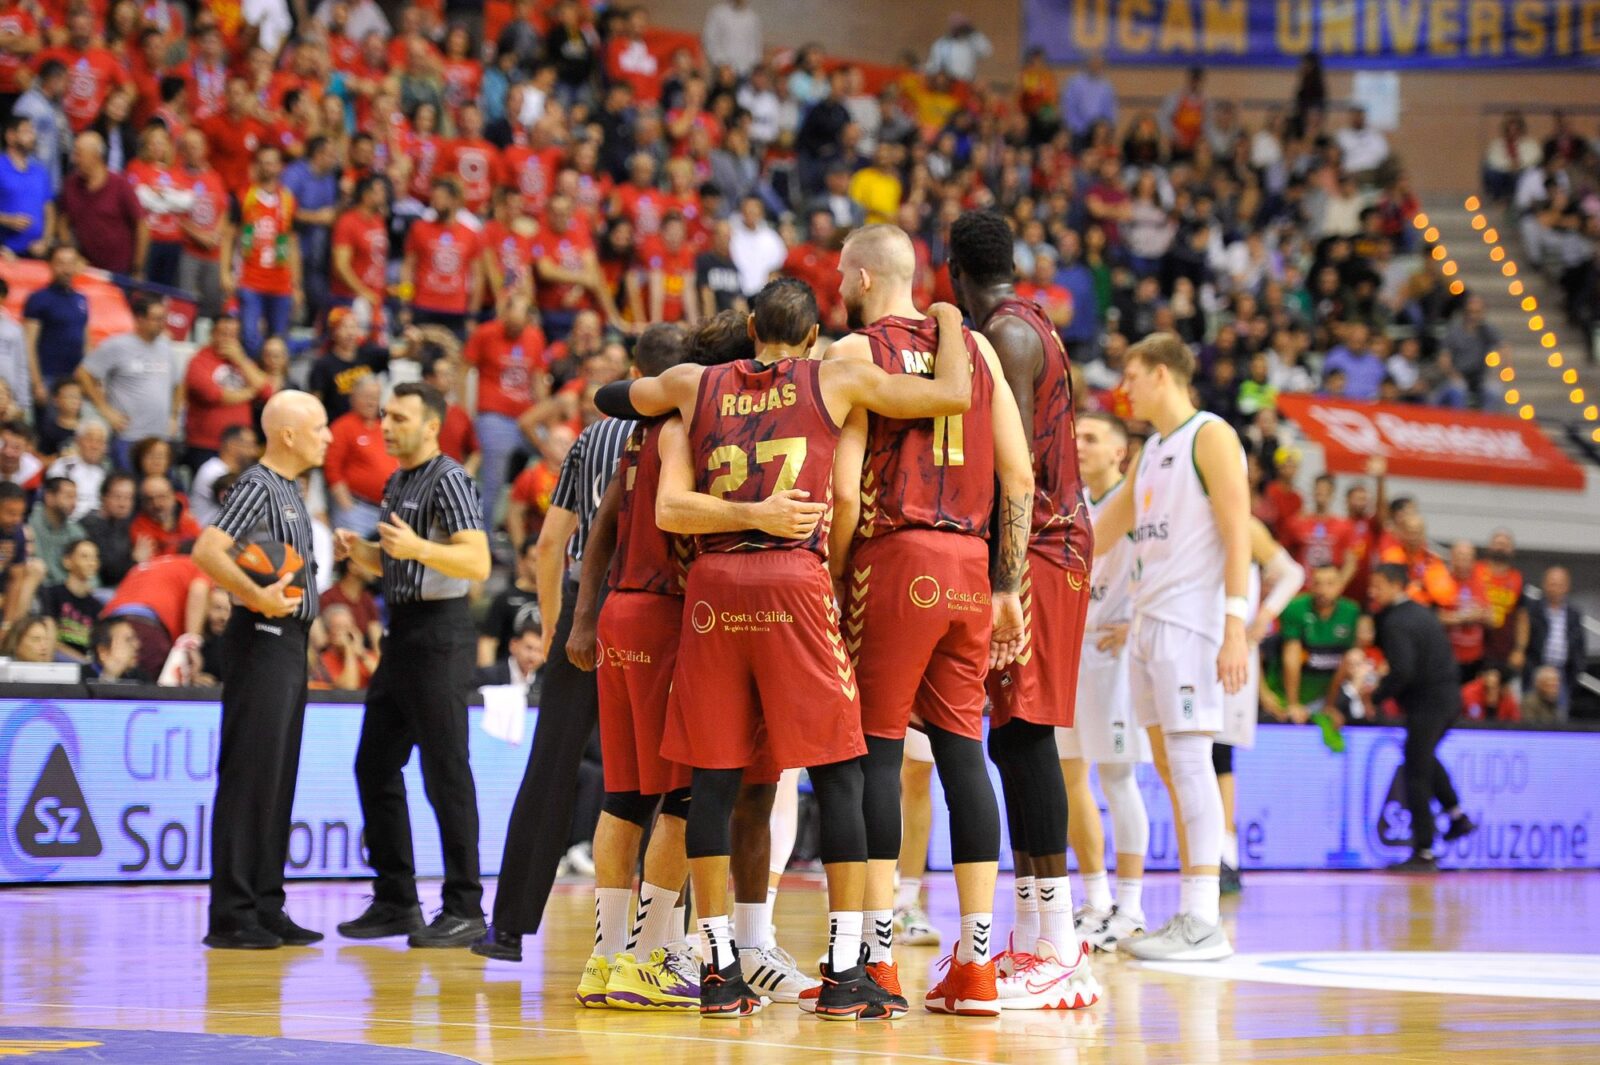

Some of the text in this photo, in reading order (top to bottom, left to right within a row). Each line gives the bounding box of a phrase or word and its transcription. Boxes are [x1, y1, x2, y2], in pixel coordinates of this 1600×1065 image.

[1071, 0, 1247, 54] UCAM
[720, 383, 797, 416] ROJAS
[933, 413, 964, 466] 11
[707, 436, 807, 501] 27
[720, 610, 794, 623] Costa Cálida
[945, 588, 972, 602] Costa
[124, 706, 216, 781] Gru
[34, 796, 82, 845] Sz
